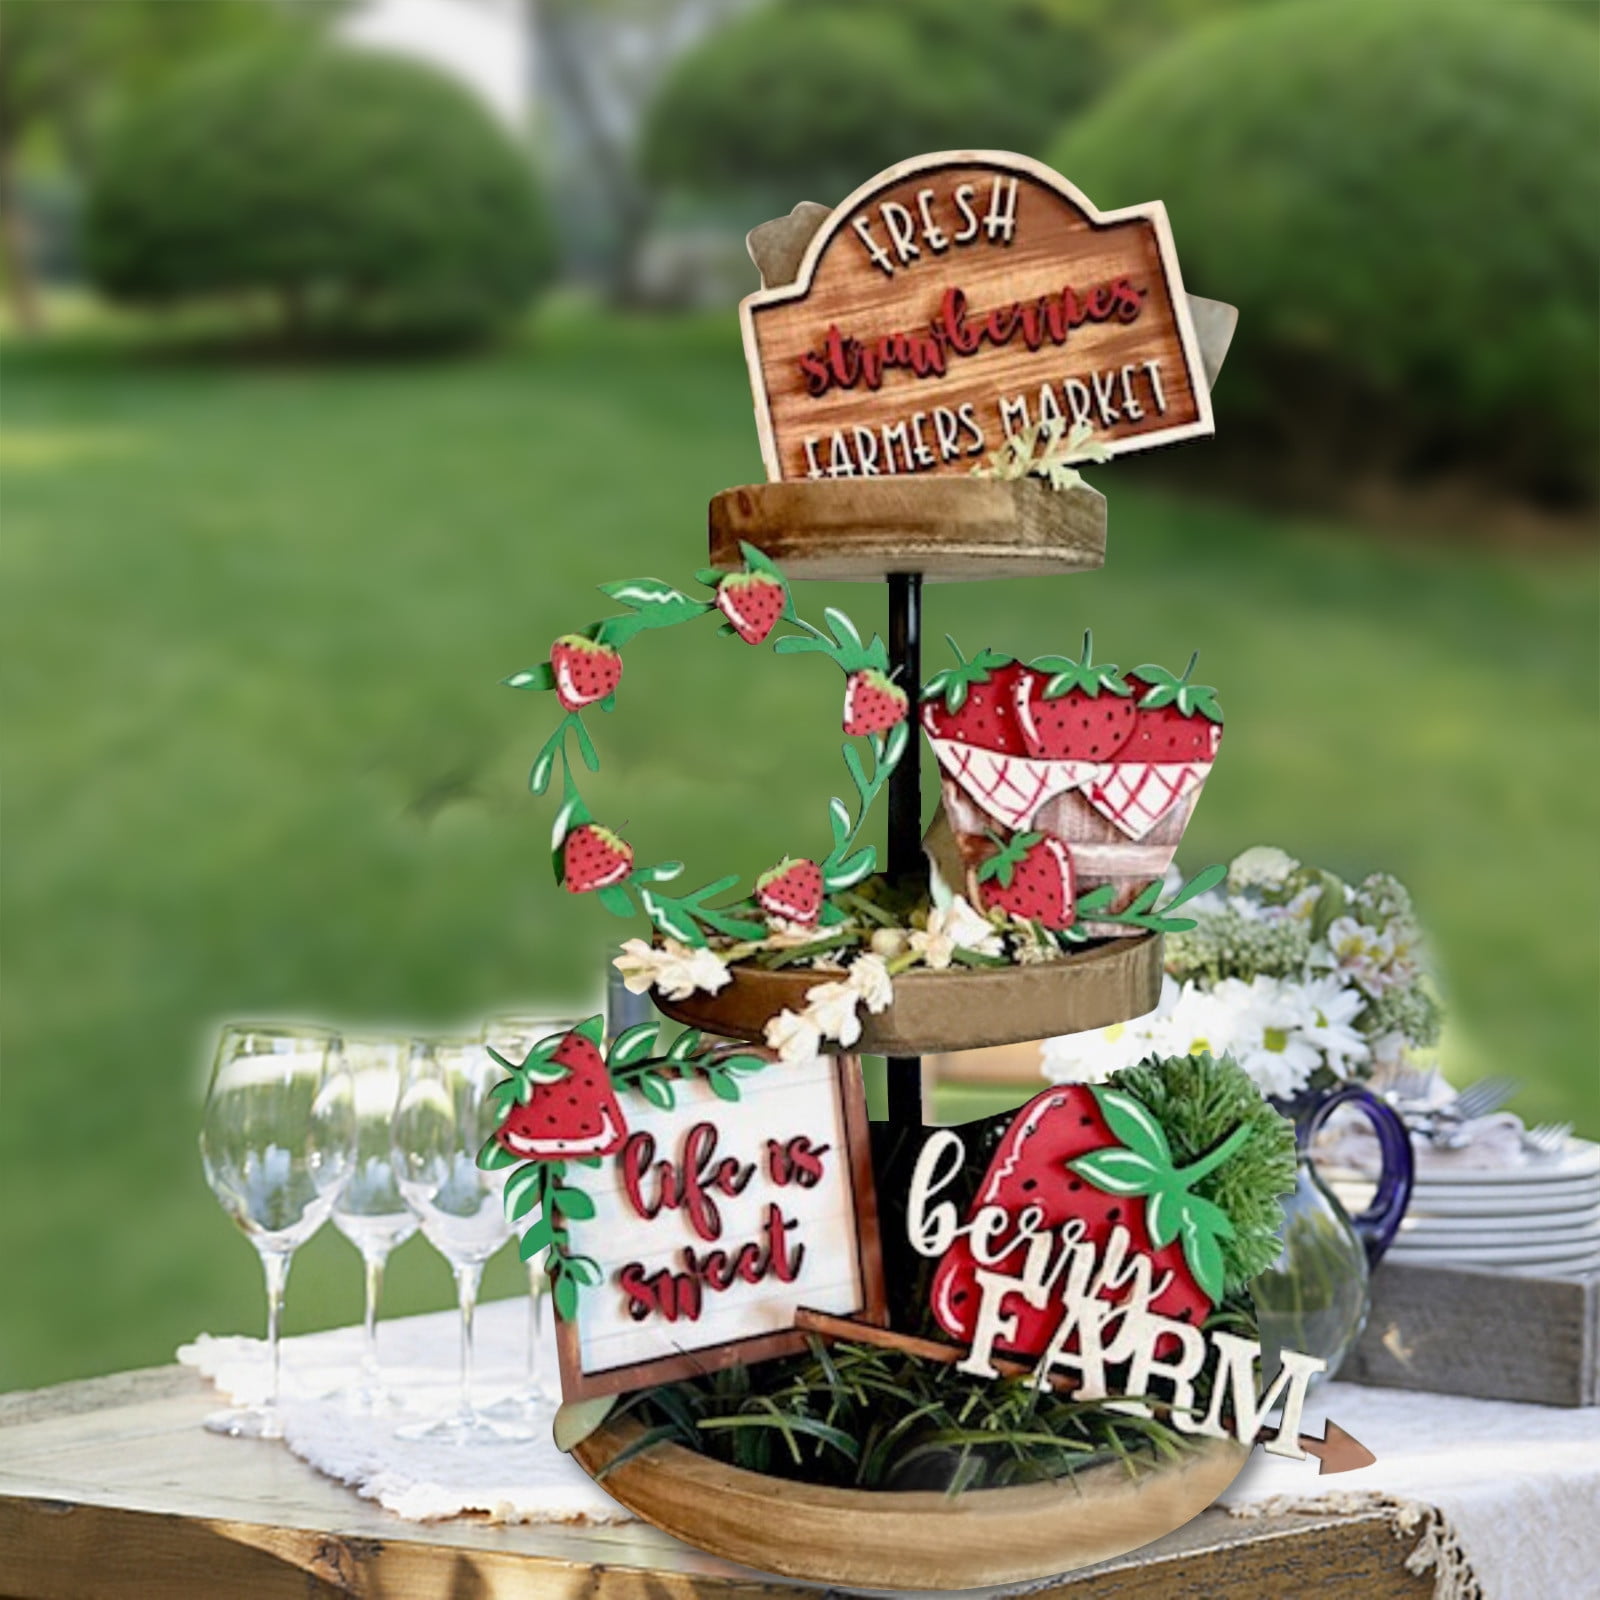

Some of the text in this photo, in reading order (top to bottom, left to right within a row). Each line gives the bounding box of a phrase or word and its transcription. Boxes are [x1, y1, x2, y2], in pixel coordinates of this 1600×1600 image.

[853, 177, 1018, 273] FRESH
[800, 278, 1147, 396] strawberries
[804, 360, 1167, 478] FARMERS MARKET
[624, 1121, 830, 1242] life is
[620, 1202, 804, 1323] sweet
[907, 1129, 1174, 1363] berry
[956, 1269, 1327, 1461] FARM
